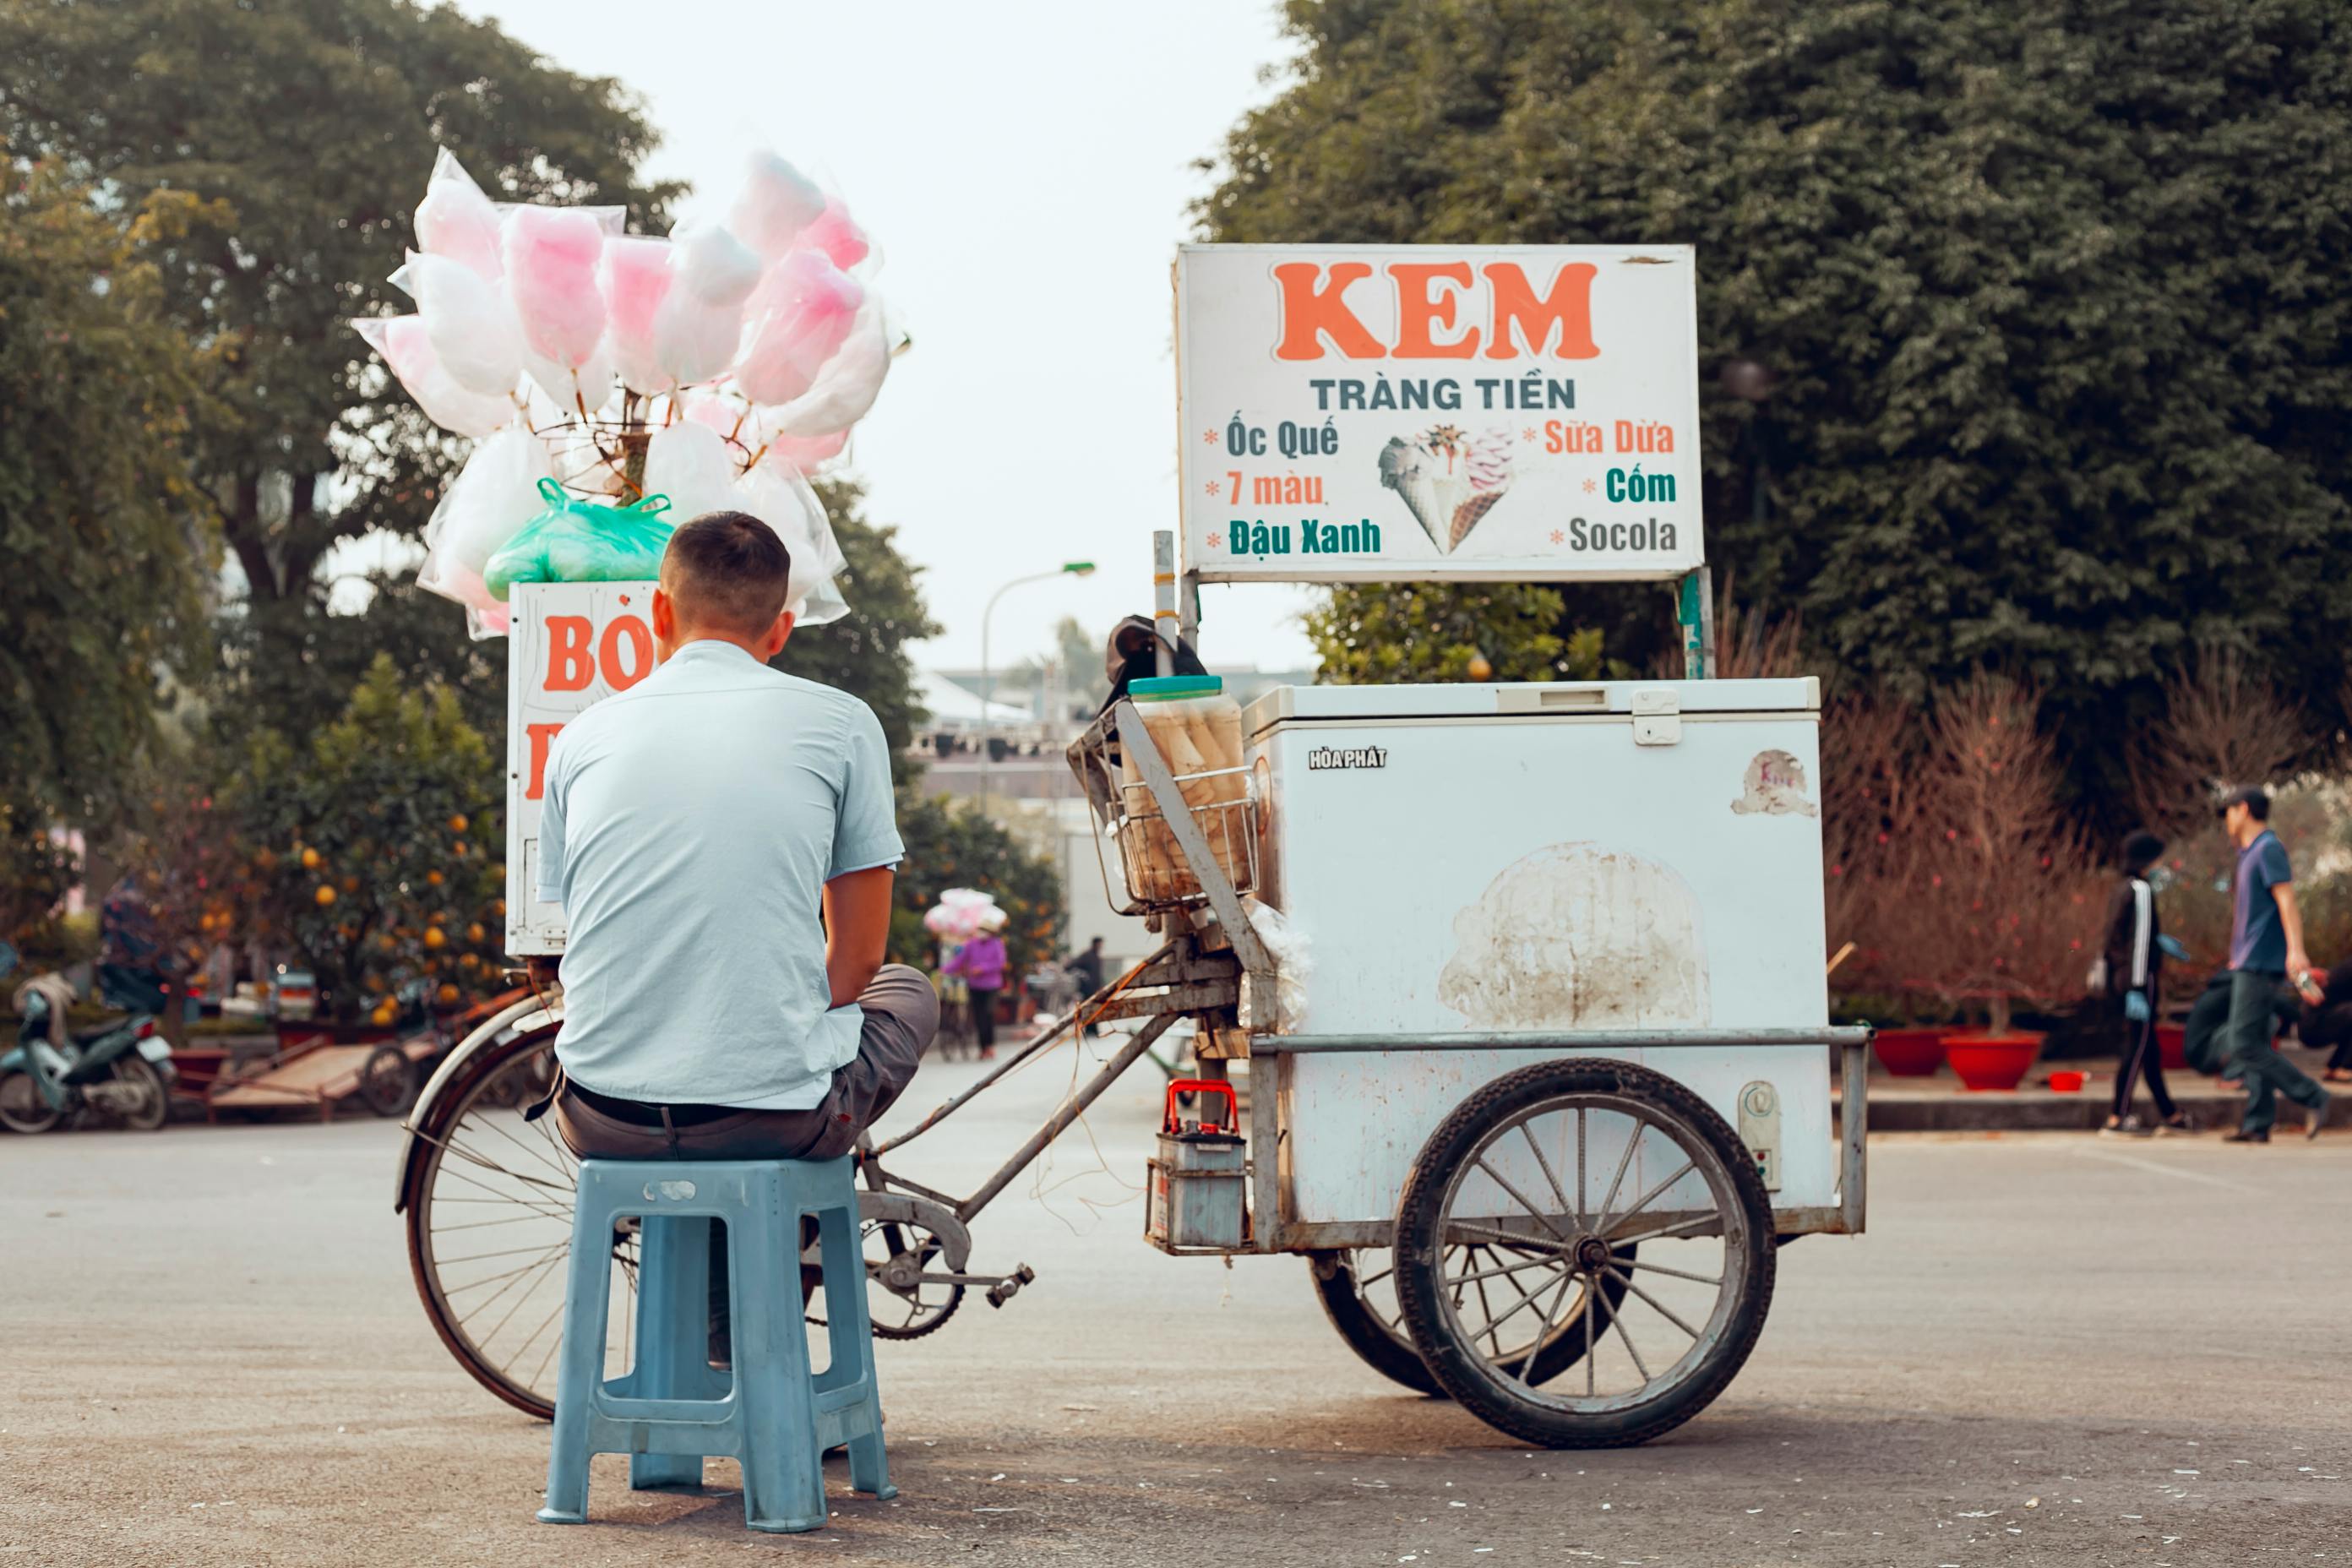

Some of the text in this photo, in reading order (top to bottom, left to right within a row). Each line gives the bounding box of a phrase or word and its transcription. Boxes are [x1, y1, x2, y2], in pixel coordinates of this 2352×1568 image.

[1273, 261, 1601, 361] KEM
[1309, 368, 1576, 411] TRÀNG TIỀN
[1227, 410, 1339, 459] Ốc Quế
[1544, 418, 1674, 454] Sữa Dừa
[1227, 470, 1323, 505] 7 màu
[1606, 462, 1676, 503] Cốm
[1228, 518, 1381, 562] Đậu Xanh
[1570, 517, 1677, 552] Socola
